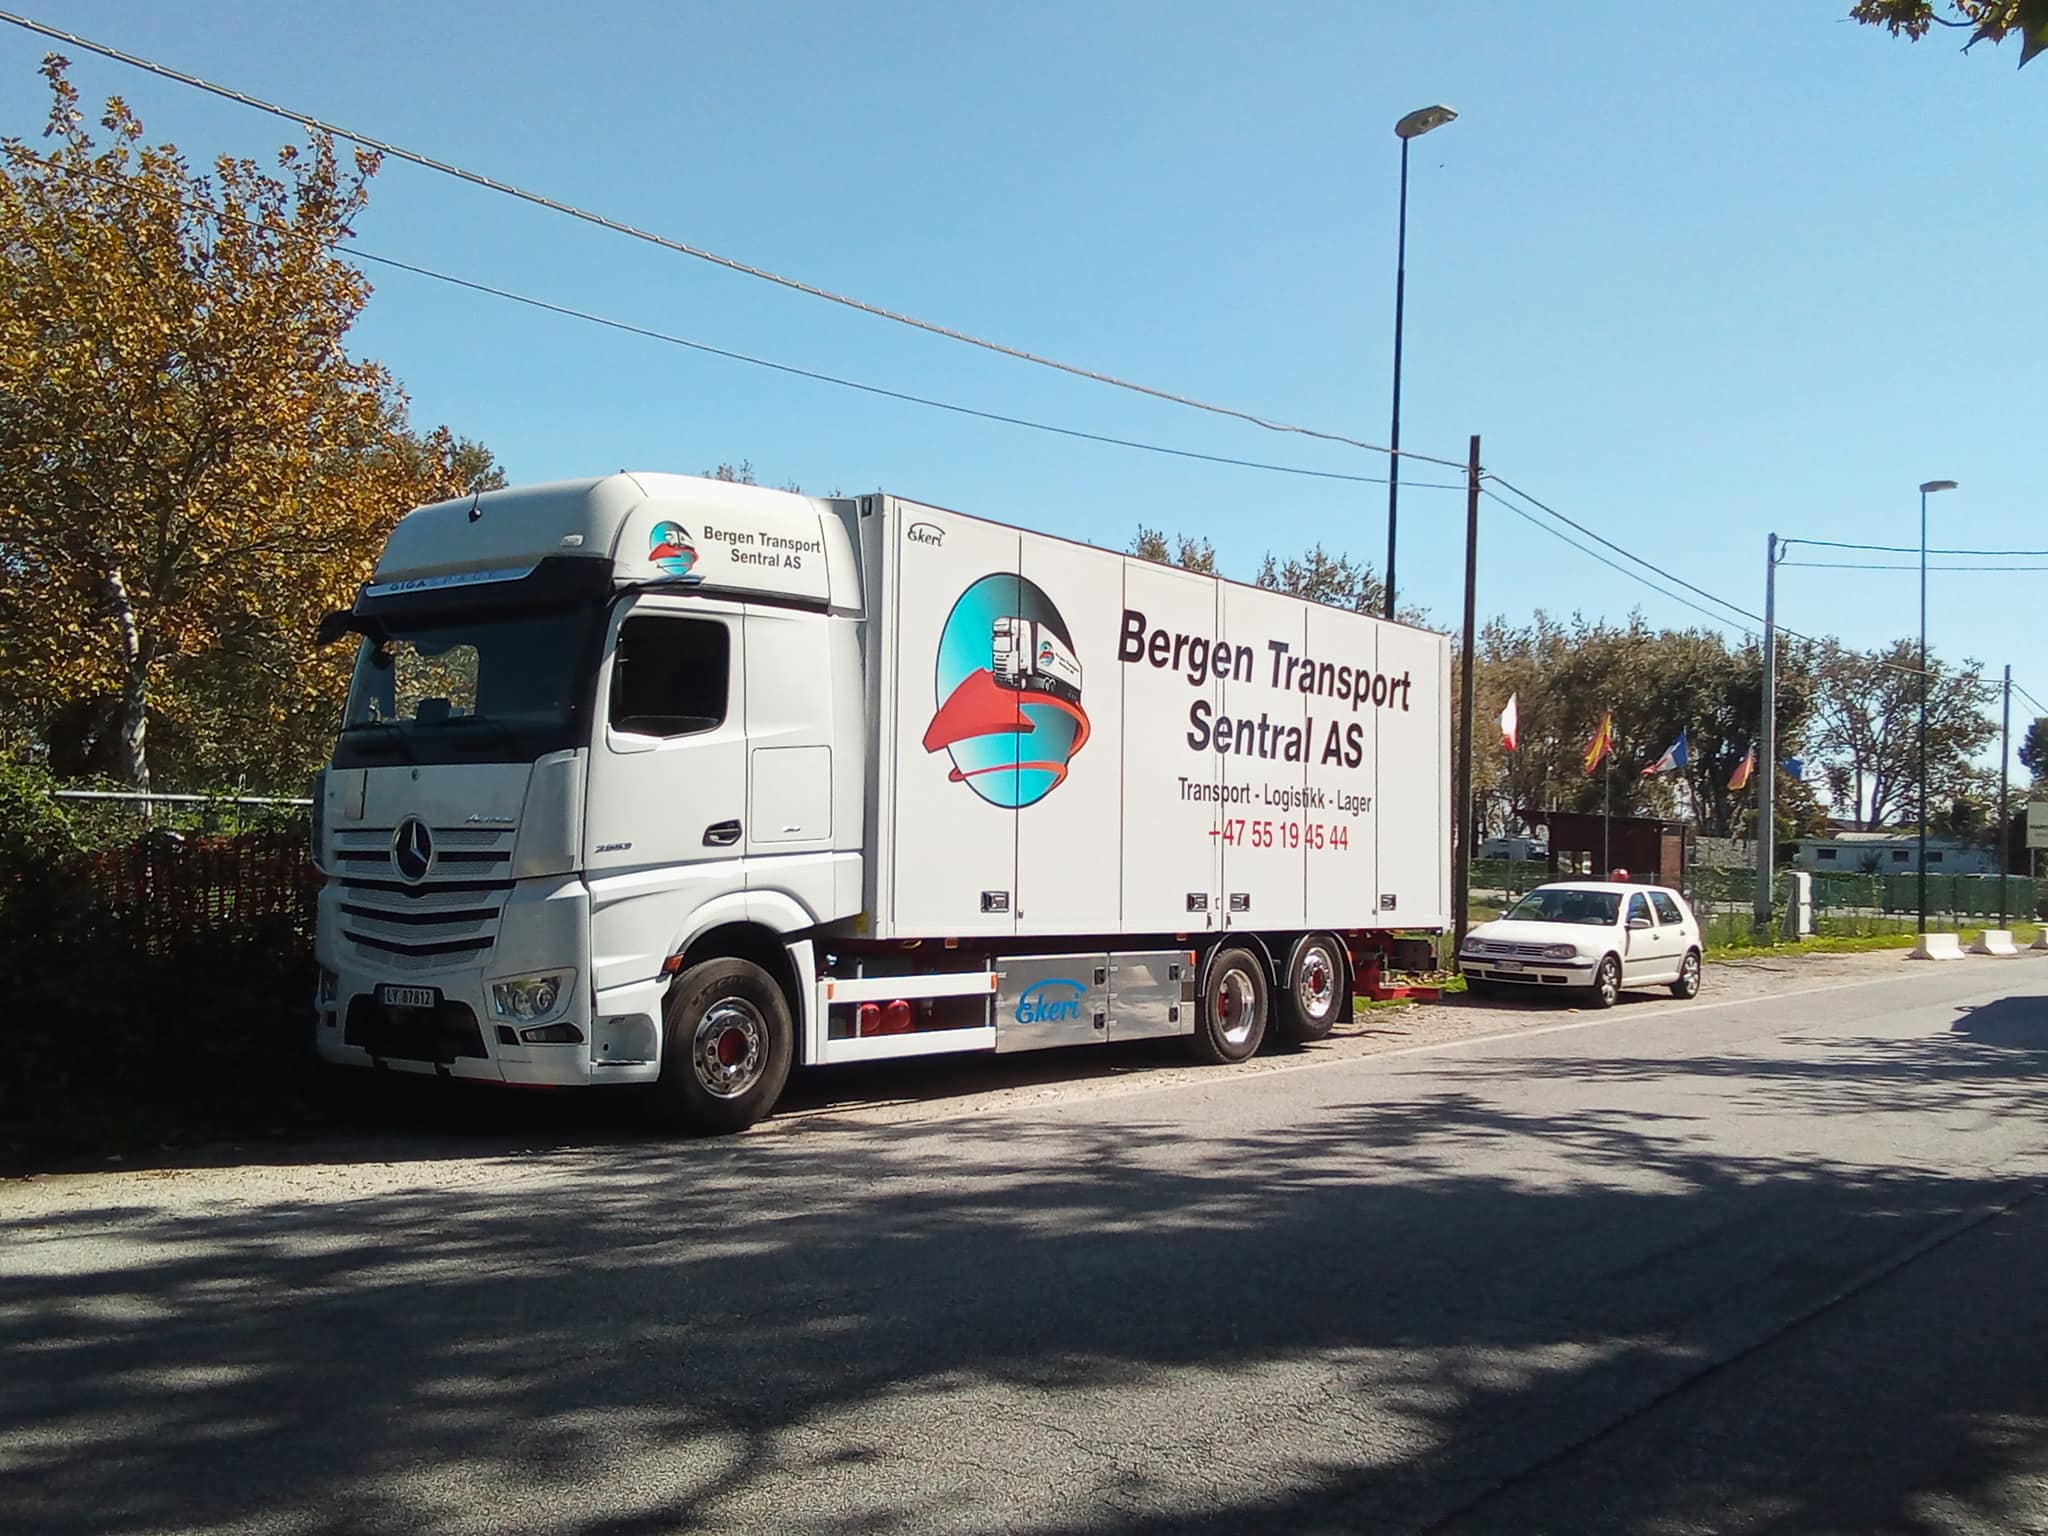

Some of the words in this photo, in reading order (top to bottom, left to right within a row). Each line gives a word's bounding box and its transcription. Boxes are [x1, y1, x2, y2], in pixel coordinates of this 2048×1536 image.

[704, 526, 754, 546] Bergen
[759, 532, 821, 554] Transport
[907, 522, 946, 547] Ekeri
[731, 548, 780, 567] Sentral
[784, 555, 801, 569] AS
[389, 581, 426, 592] GIGA
[1117, 608, 1254, 687] Bergen
[1268, 639, 1411, 712] Transport
[1186, 699, 1313, 764] Sentral
[1321, 720, 1364, 768] AS
[1178, 777, 1251, 808] Transport
[1264, 783, 1326, 812] Logistikk
[1337, 789, 1372, 817] Lager
[1208, 819, 1246, 847] +47
[1252, 821, 1273, 847] 55
[1279, 822, 1299, 848] 19
[1304, 824, 1324, 849] 45
[1329, 825, 1348, 850] 44
[387, 989, 398, 1003] LY
[1015, 978, 1088, 1024] Ekeri
